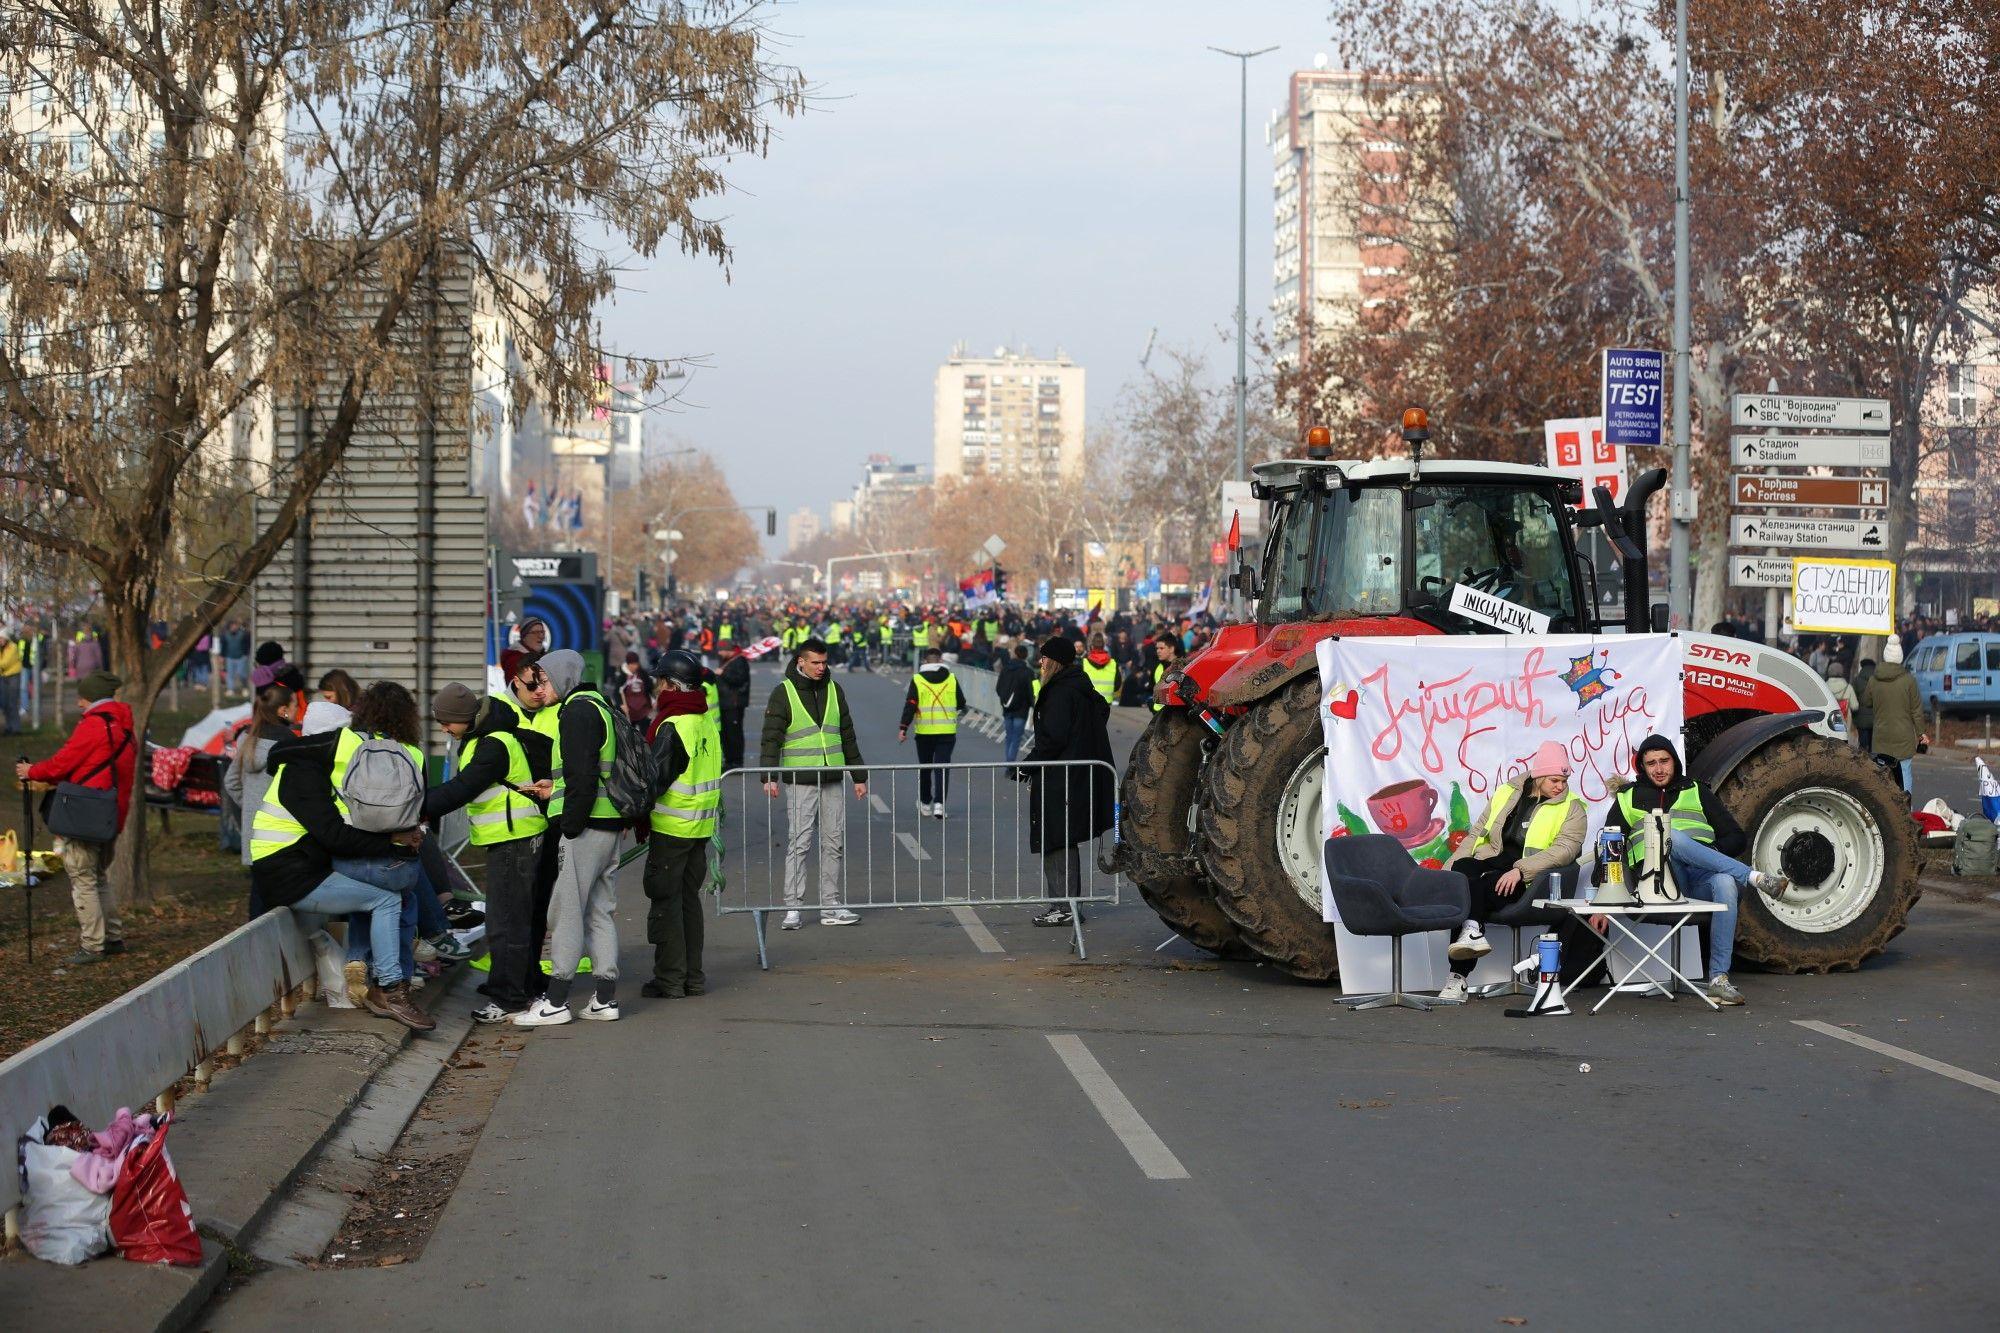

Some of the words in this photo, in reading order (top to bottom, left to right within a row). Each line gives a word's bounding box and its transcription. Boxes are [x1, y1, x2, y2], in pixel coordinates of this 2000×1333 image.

[1610, 357, 1633, 367] AUTO
[1635, 358, 1660, 368] SERVIS
[1610, 369, 1634, 379] RENT
[1635, 370, 1642, 379] A
[1643, 370, 1659, 380] CAR
[1609, 383, 1659, 406] TEST
[1760, 399, 1781, 411] СПЦ
[1783, 400, 1841, 412] "Војводина"
[1614, 411, 1655, 420] PETROVARADIN
[1760, 411, 1780, 421] SBC
[1782, 412, 1836, 424] "Vojvodina"
[1759, 438, 1799, 450] Стадион
[1759, 450, 1797, 461] Stadium
[1758, 478, 1798, 491] Тврђава
[1758, 490, 1796, 501] Fortress
[1760, 518, 1815, 531] Железничка
[1817, 521, 1855, 533] станица
[1759, 531, 1794, 545] Railway
[1796, 532, 1828, 544] Station
[1757, 560, 1794, 570] Клинич
[1757, 572, 1792, 585] Hospita
[1798, 566, 1890, 595] СТУДЕНТИ
[1795, 593, 1890, 618] ОСЛОБОДИОЦИ
[1689, 643, 1751, 668] STEYR
[1727, 677, 1755, 691] MULTI
